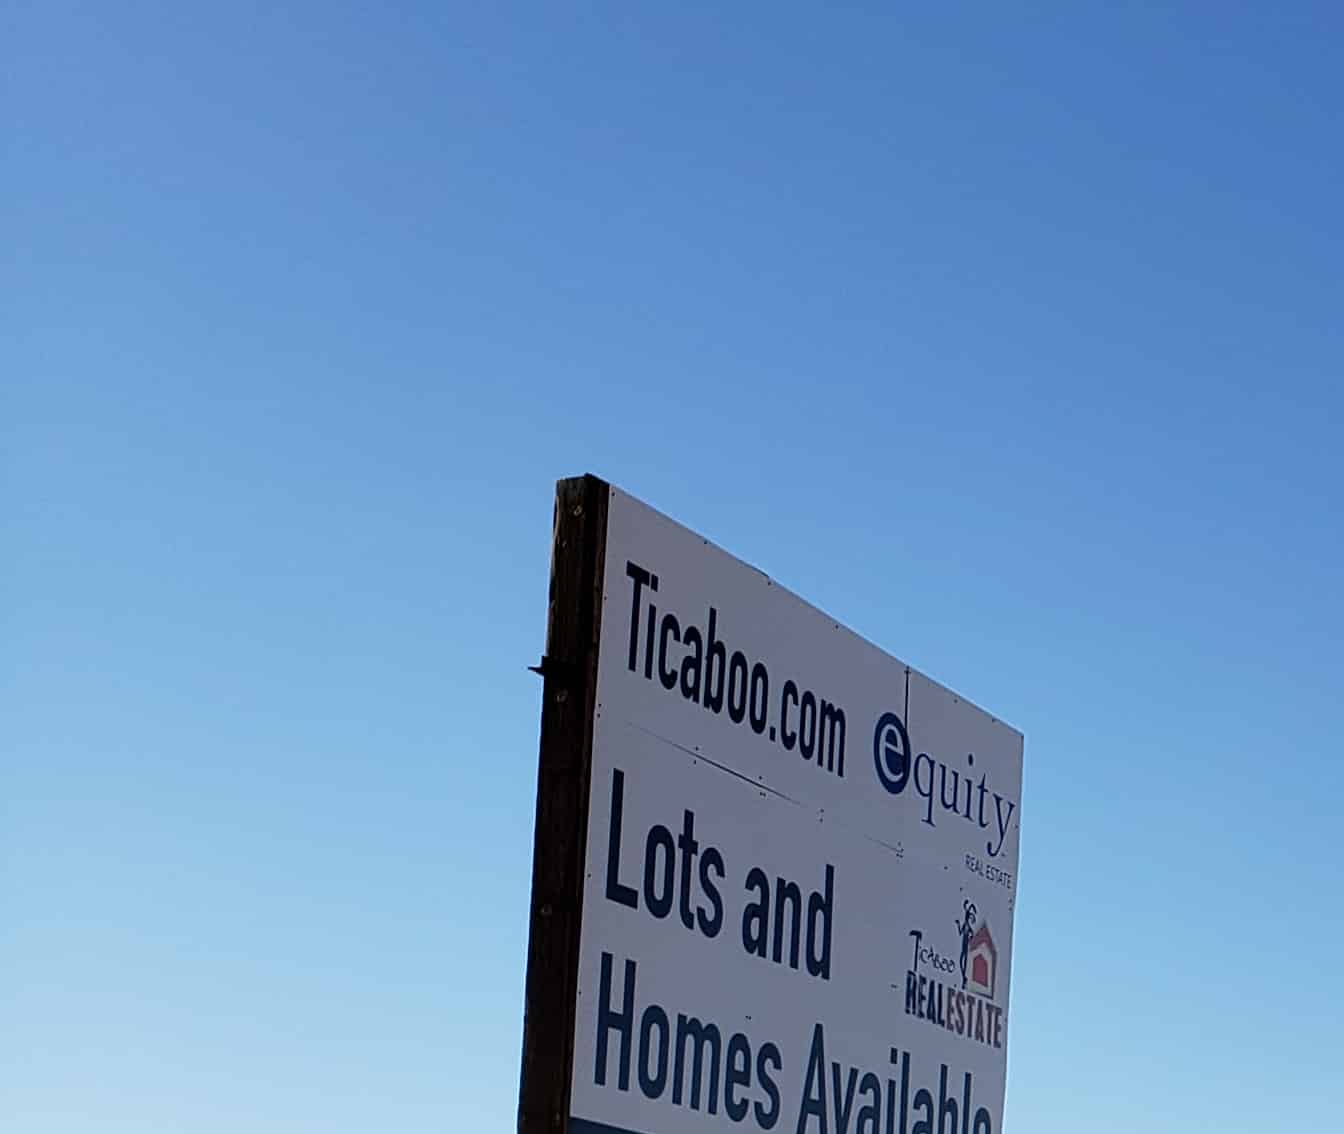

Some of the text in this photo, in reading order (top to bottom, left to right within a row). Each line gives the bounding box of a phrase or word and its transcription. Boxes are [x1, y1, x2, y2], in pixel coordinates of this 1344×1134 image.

[626, 560, 846, 777] Ticaboo.com
[606, 767, 834, 980] Lots and
[874, 712, 1015, 857] equity
[986, 864, 1012, 889] ESTATE
[594, 951, 783, 1130] Homes
